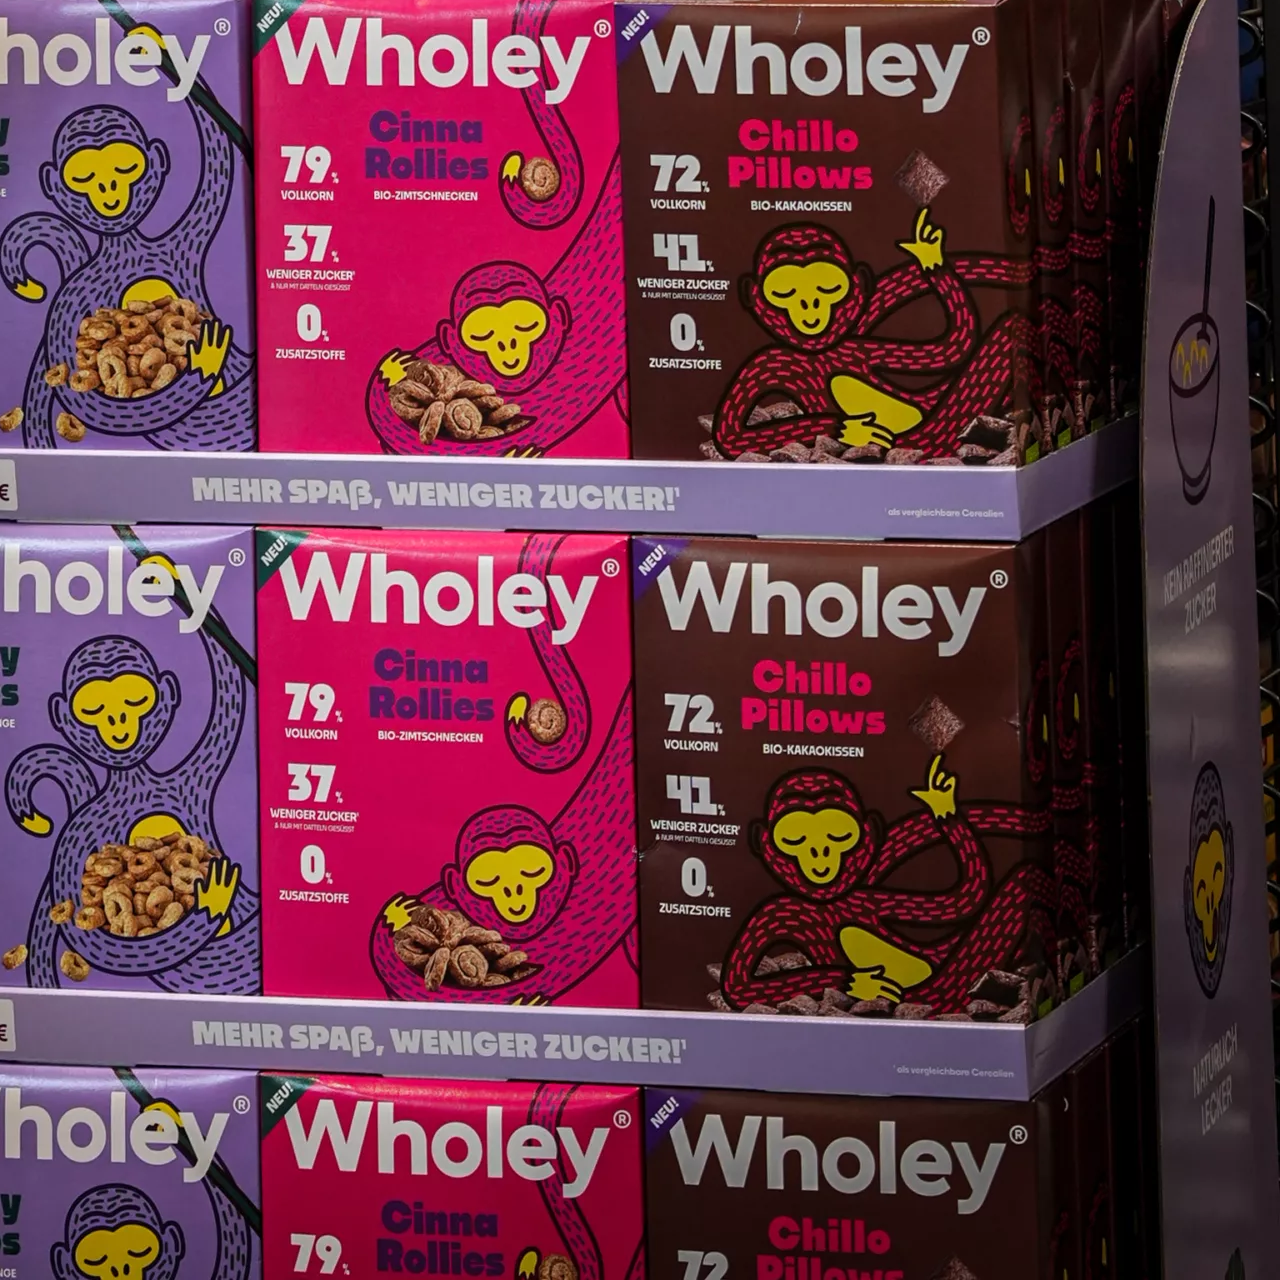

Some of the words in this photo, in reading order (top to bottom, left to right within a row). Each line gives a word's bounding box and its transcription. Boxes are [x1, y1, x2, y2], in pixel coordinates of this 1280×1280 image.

[256, 2, 284, 33] NEU!
[621, 10, 650, 41] NEU!
[369, 111, 483, 143] Cinna
[738, 119, 858, 153] Chillo
[365, 148, 489, 180] Rollies
[728, 157, 872, 189] Pillows
[281, 190, 334, 201] VOLLKORN
[373, 190, 478, 202] BIO-ZIMTSCHNECKEN
[650, 199, 706, 210] VOLLKORN
[751, 200, 852, 212] BIO-KAKAOKISSEN
[266, 269, 312, 279] WENIGER
[637, 278, 685, 289] WENIGER
[276, 348, 345, 360] ZUSATZSTOFFE
[649, 358, 722, 370] ZUSATZSTOFFE
[192, 477, 283, 504] MEHR
[387, 481, 534, 510] WENIGER
[901, 509, 960, 518] vergleichbare
[962, 509, 1004, 518] Cerealien
[260, 537, 289, 567] NEU!
[638, 545, 667, 576] NEU!
[1164, 563, 1183, 606] KEIN
[1183, 525, 1234, 591] RAFFINIERTER
[1185, 582, 1216, 635] ZUCKER
[374, 648, 488, 684] Cinna
[753, 659, 872, 697] Chillo
[369, 686, 495, 721] Rollies
[741, 697, 885, 735] Pillows
[285, 728, 338, 740] VOLLKORN
[378, 731, 483, 743] BIO-ZIMTSCHNECKEN
[664, 739, 719, 752] VOLLKORN
[762, 744, 864, 757] BIO-KAKAOKISSEN
[270, 807, 316, 821] WENIGER
[650, 819, 697, 833] WENIGER
[279, 890, 349, 904] ZUSATZSTOFFE
[659, 902, 731, 918] ZUSATZSTOFFE
[192, 1020, 284, 1048] MEHR
[388, 1029, 538, 1059] WENIGER
[911, 1066, 970, 1076] vergleichbare
[972, 1068, 1014, 1078] Cerealien
[1193, 1022, 1237, 1099] NATÜRLICH
[266, 1082, 295, 1115] NEU!
[650, 1096, 680, 1129] NEU!
[1202, 1074, 1232, 1135] LECKER
[381, 1200, 498, 1237] Cinna
[768, 1216, 891, 1254] Chillo
[377, 1238, 505, 1276] Rollies
